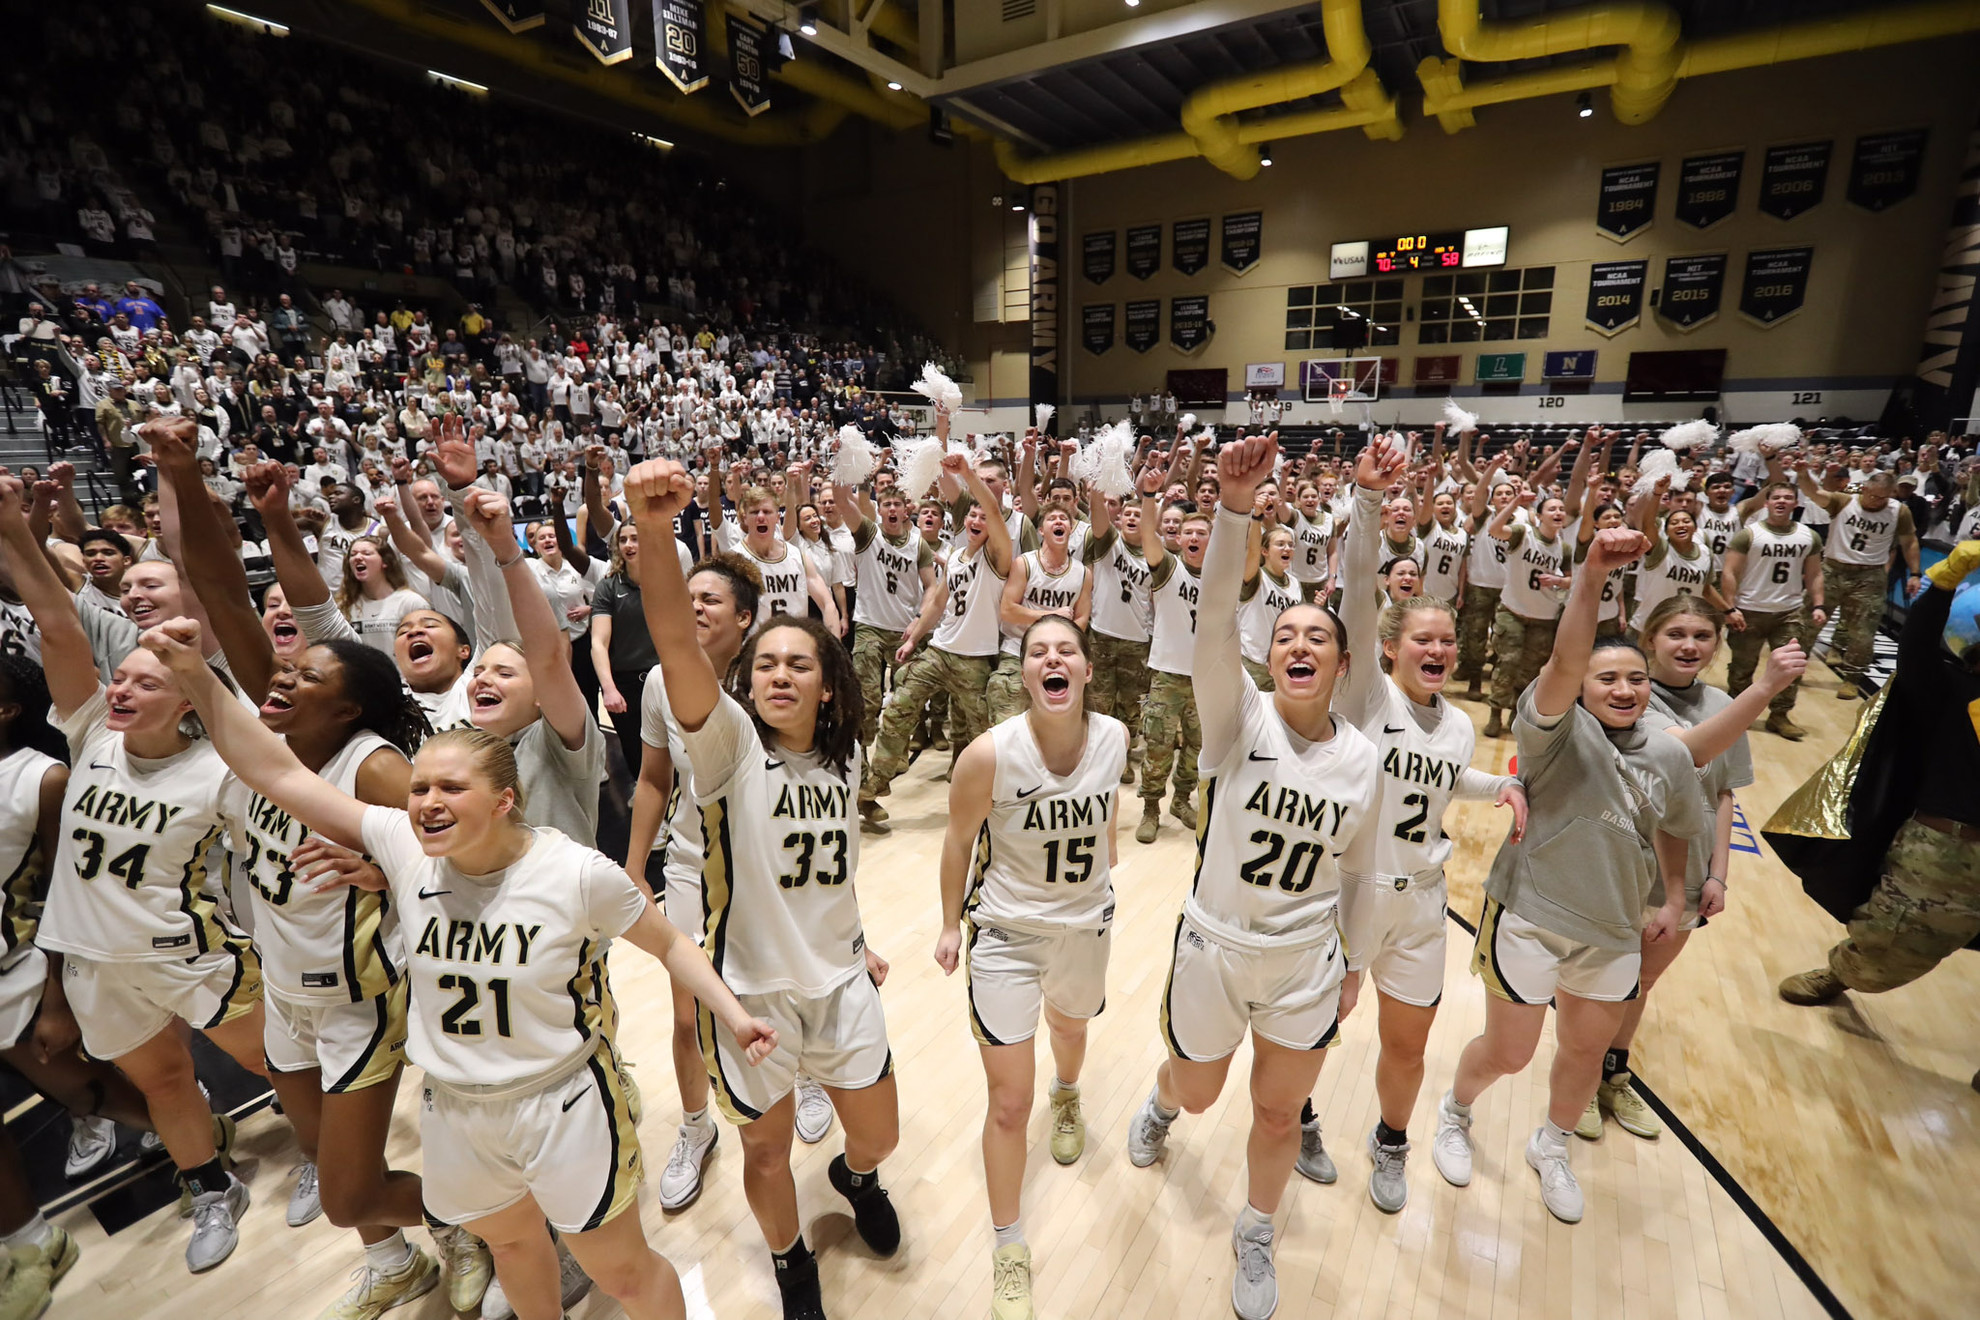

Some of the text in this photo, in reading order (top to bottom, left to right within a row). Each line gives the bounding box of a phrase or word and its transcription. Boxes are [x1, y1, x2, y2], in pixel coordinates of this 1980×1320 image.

[669, 3, 689, 18] MIKE
[665, 23, 697, 57] 20
[737, 51, 760, 82] 50
[1767, 160, 1826, 173] TOURNAMENT
[1784, 155, 1810, 164] NCAA
[1604, 180, 1654, 192] TOURNAMENT
[1618, 175, 1640, 184] NCAA
[1684, 170, 1737, 183] TOURNAMENT
[1608, 198, 1644, 213] 1984
[1344, 256, 1365, 265] USAA
[1376, 258, 1391, 272] 70
[1410, 256, 1419, 269] 4
[1441, 252, 1460, 266] 58
[1768, 261, 1788, 269] NCAA
[1032, 186, 1058, 374] GO ARMY
[1752, 266, 1802, 276] TOURNAMENT
[1592, 277, 1642, 287] TOURNAMENT
[1753, 285, 1793, 298] 2016
[1597, 294, 1631, 306] 2014
[1672, 288, 1709, 301] 2015
[1538, 397, 1564, 408] 120
[1792, 392, 1822, 405] 121
[1704, 518, 1737, 532] ARMY
[1845, 514, 1889, 535] ARMY
[1300, 530, 1330, 547] ARMY
[1433, 537, 1465, 554] ARMY
[1712, 535, 1727, 555] 6
[1850, 532, 1869, 552] 6
[876, 548, 913, 573] ARMY
[1306, 547, 1317, 566] 6
[1522, 548, 1559, 570] ARMY
[1761, 543, 1807, 558] ARMY
[1114, 554, 1150, 586] ARMY
[1437, 555, 1452, 574] 6
[1666, 565, 1707, 584] ARMY
[1772, 561, 1790, 584] 6
[766, 574, 799, 594] RMY
[886, 571, 898, 595] 6
[1121, 580, 1132, 603] 6
[1178, 581, 1200, 604] AR
[1602, 581, 1613, 601] 6
[953, 590, 967, 616] 6
[1028, 587, 1077, 608] ARMY
[1383, 747, 1461, 791] ARMY
[72, 785, 185, 835] ARMY
[772, 784, 850, 819] ARMY
[1023, 791, 1110, 831] ARMY
[1244, 780, 1351, 838] ARMY
[1393, 793, 1429, 844] 2
[72, 827, 152, 891] 34
[779, 830, 847, 889] 33
[1043, 835, 1096, 883] 15
[1240, 829, 1325, 894] 20
[416, 917, 543, 965] ARMY
[437, 974, 513, 1038] 21
